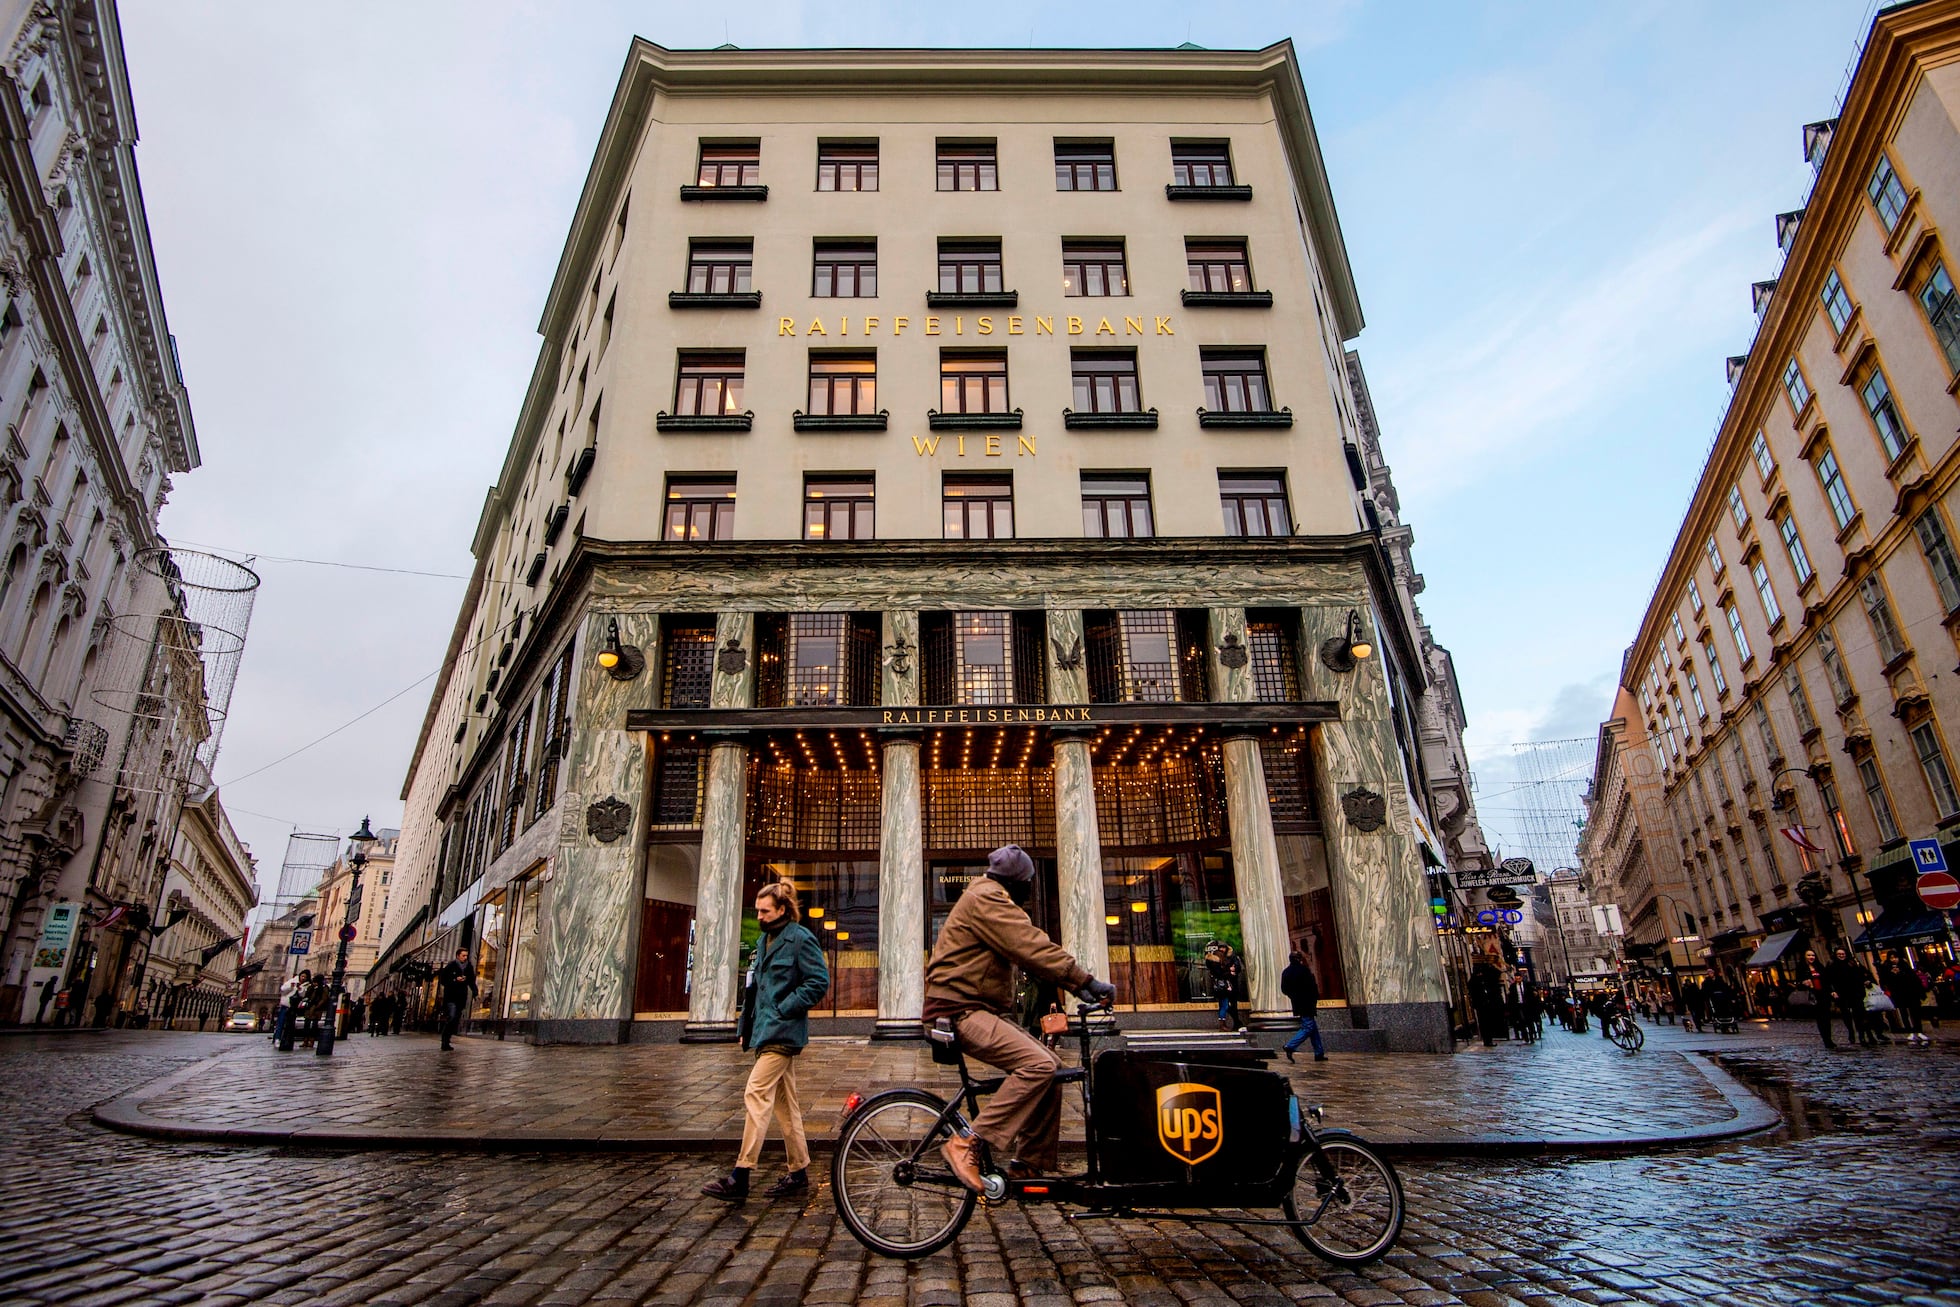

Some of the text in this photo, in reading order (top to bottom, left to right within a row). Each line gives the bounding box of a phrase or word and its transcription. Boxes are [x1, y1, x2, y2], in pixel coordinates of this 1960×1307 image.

[778, 316, 1175, 336] RAIFFEISENBANK
[912, 435, 1037, 457] WIEN
[883, 708, 1092, 723] RAIFFEISENBANK
[1162, 1108, 1218, 1151] ups
